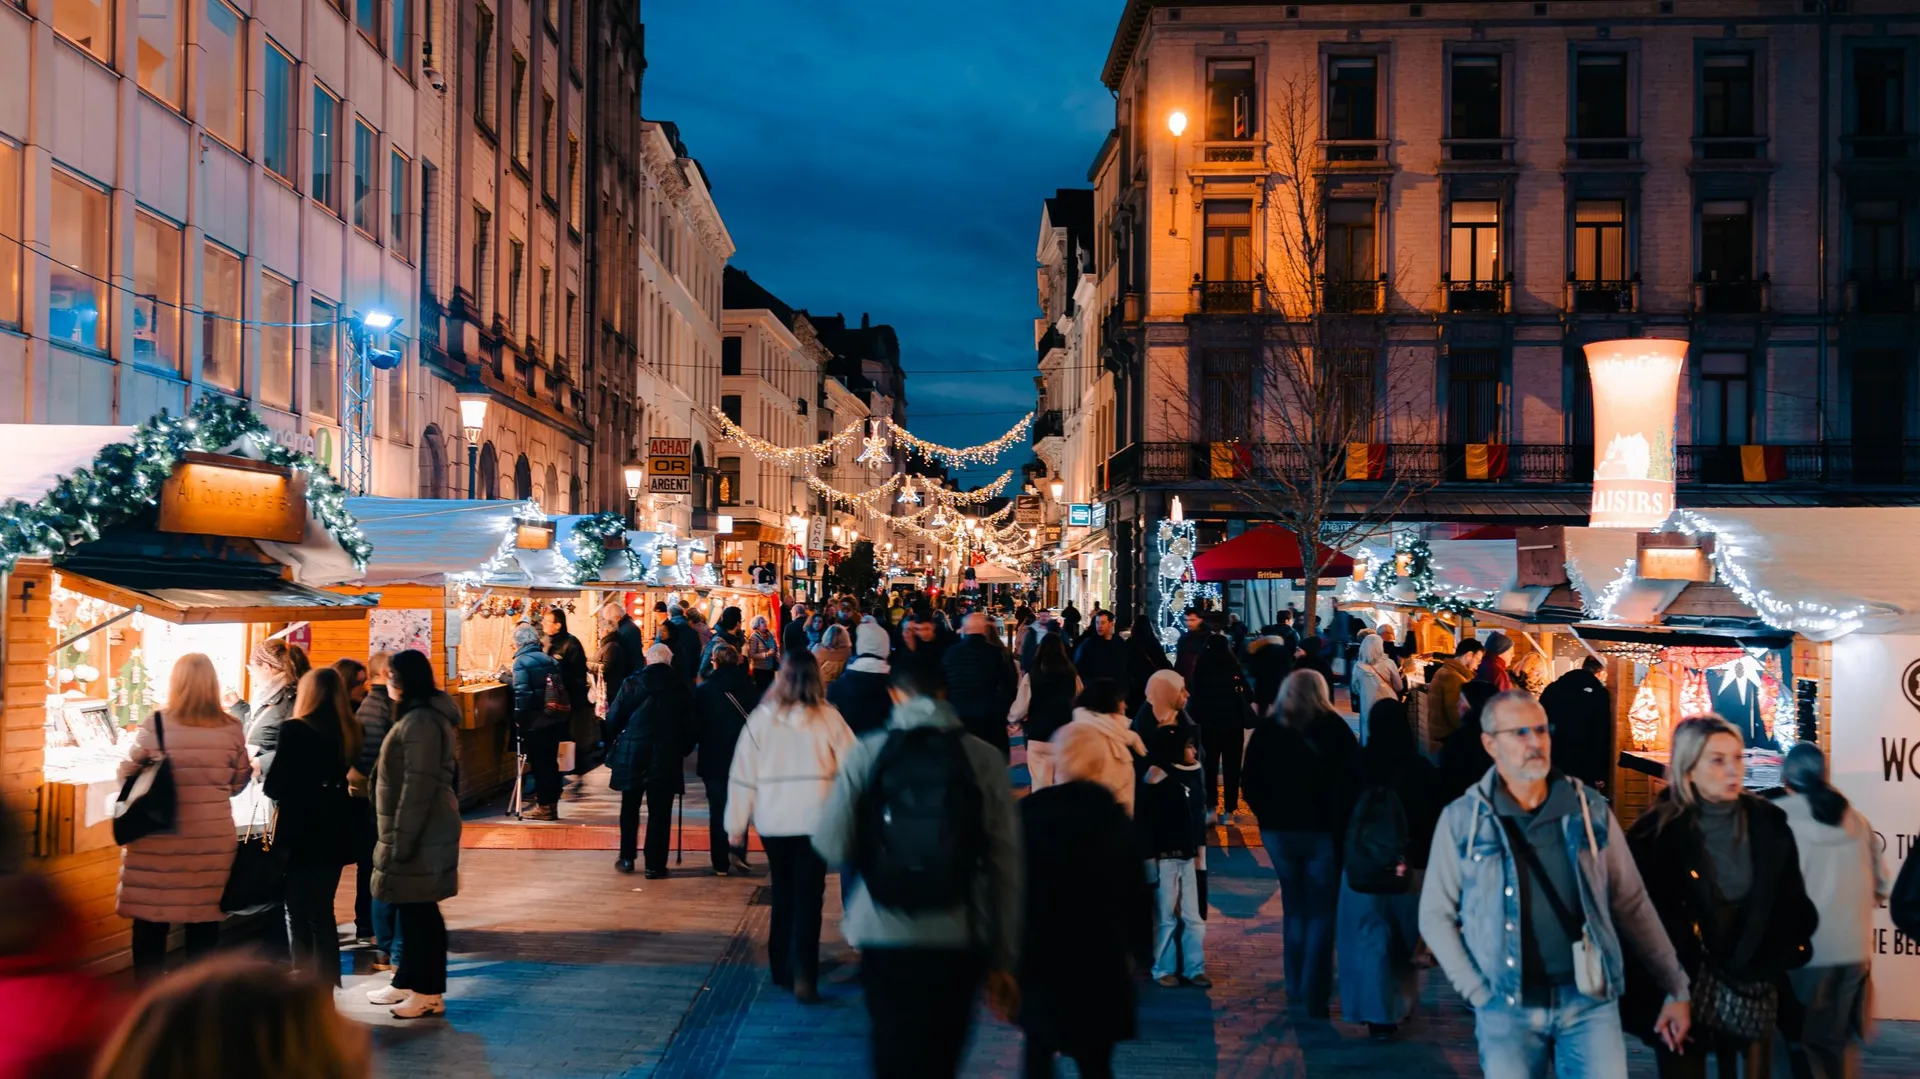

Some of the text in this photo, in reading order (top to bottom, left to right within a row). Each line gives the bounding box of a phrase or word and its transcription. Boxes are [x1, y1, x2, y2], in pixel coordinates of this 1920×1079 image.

[651, 440, 689, 455] ACHAT
[655, 460, 685, 471] OR
[651, 478, 689, 490] ARGENT
[813, 516, 823, 549] ACHAT
